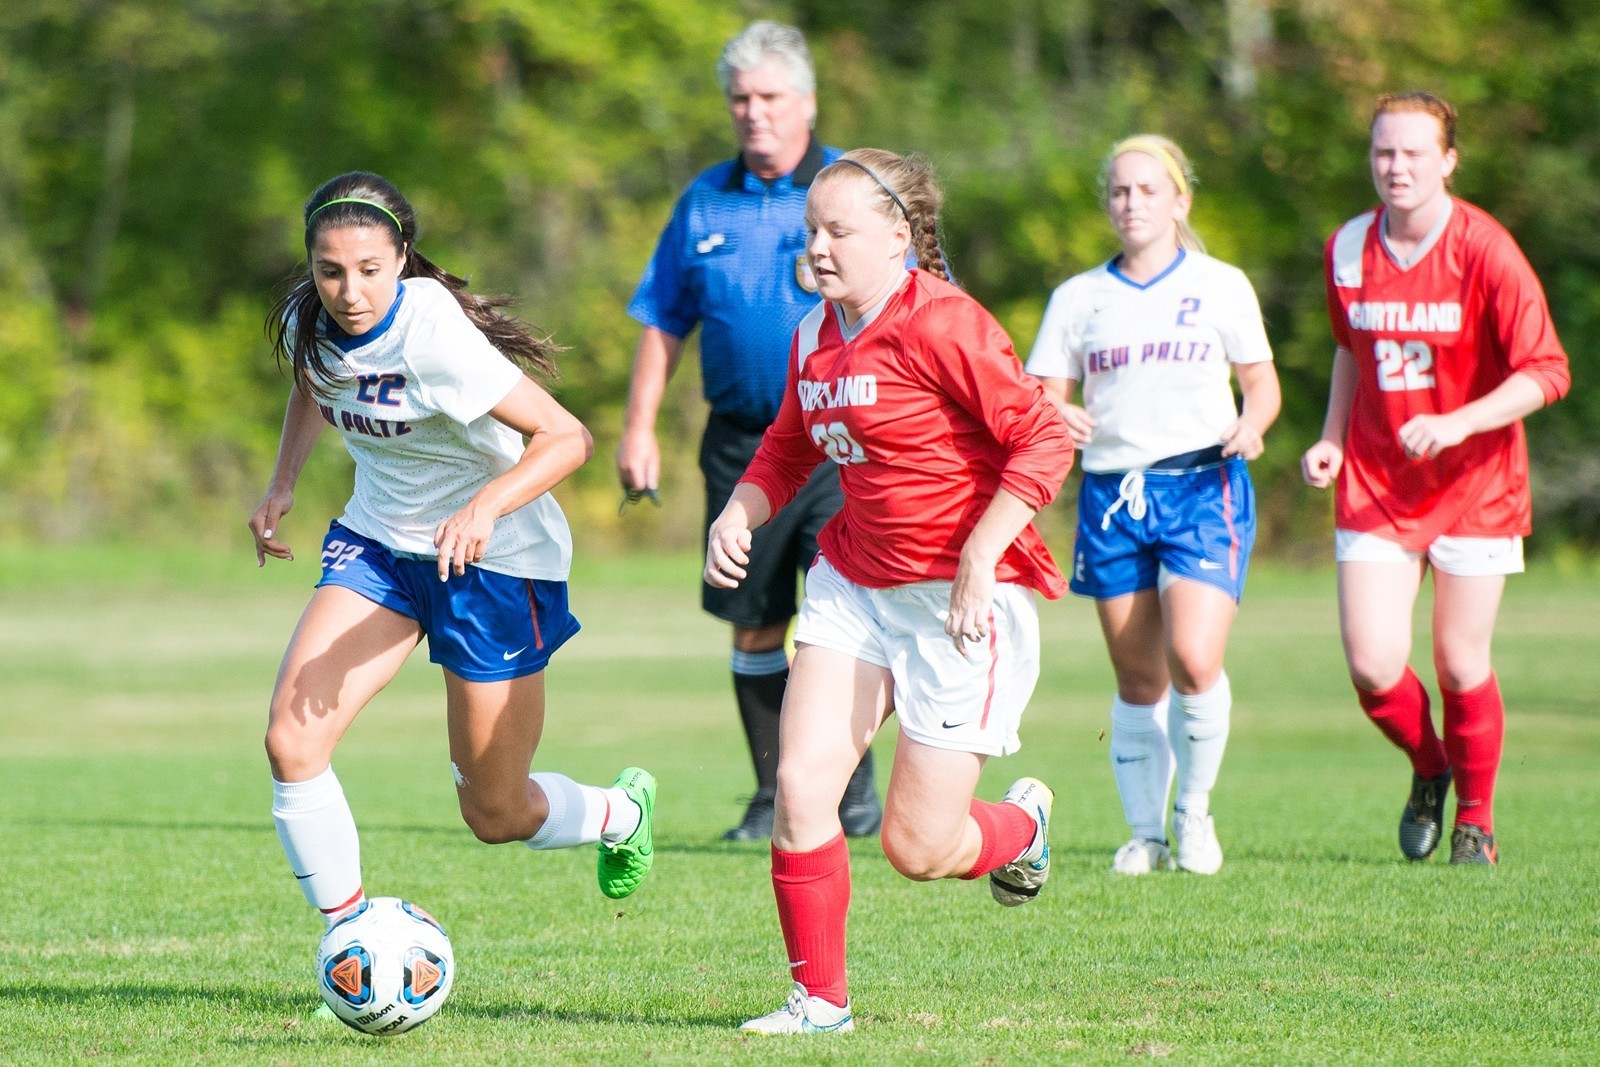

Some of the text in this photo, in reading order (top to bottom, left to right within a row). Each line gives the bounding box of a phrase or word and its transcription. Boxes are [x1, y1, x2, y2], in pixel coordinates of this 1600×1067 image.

[1176, 297, 1201, 327] 2
[1348, 301, 1462, 332] CORTLAND
[1088, 341, 1212, 376] NEW PALTZ
[1374, 340, 1436, 392] 22
[356, 373, 407, 408] 22
[797, 374, 878, 412] ORTLAND
[811, 421, 869, 467] 20
[320, 539, 365, 571] 22
[354, 1003, 395, 1026] Wilson
[375, 1015, 409, 1035] NCAA
